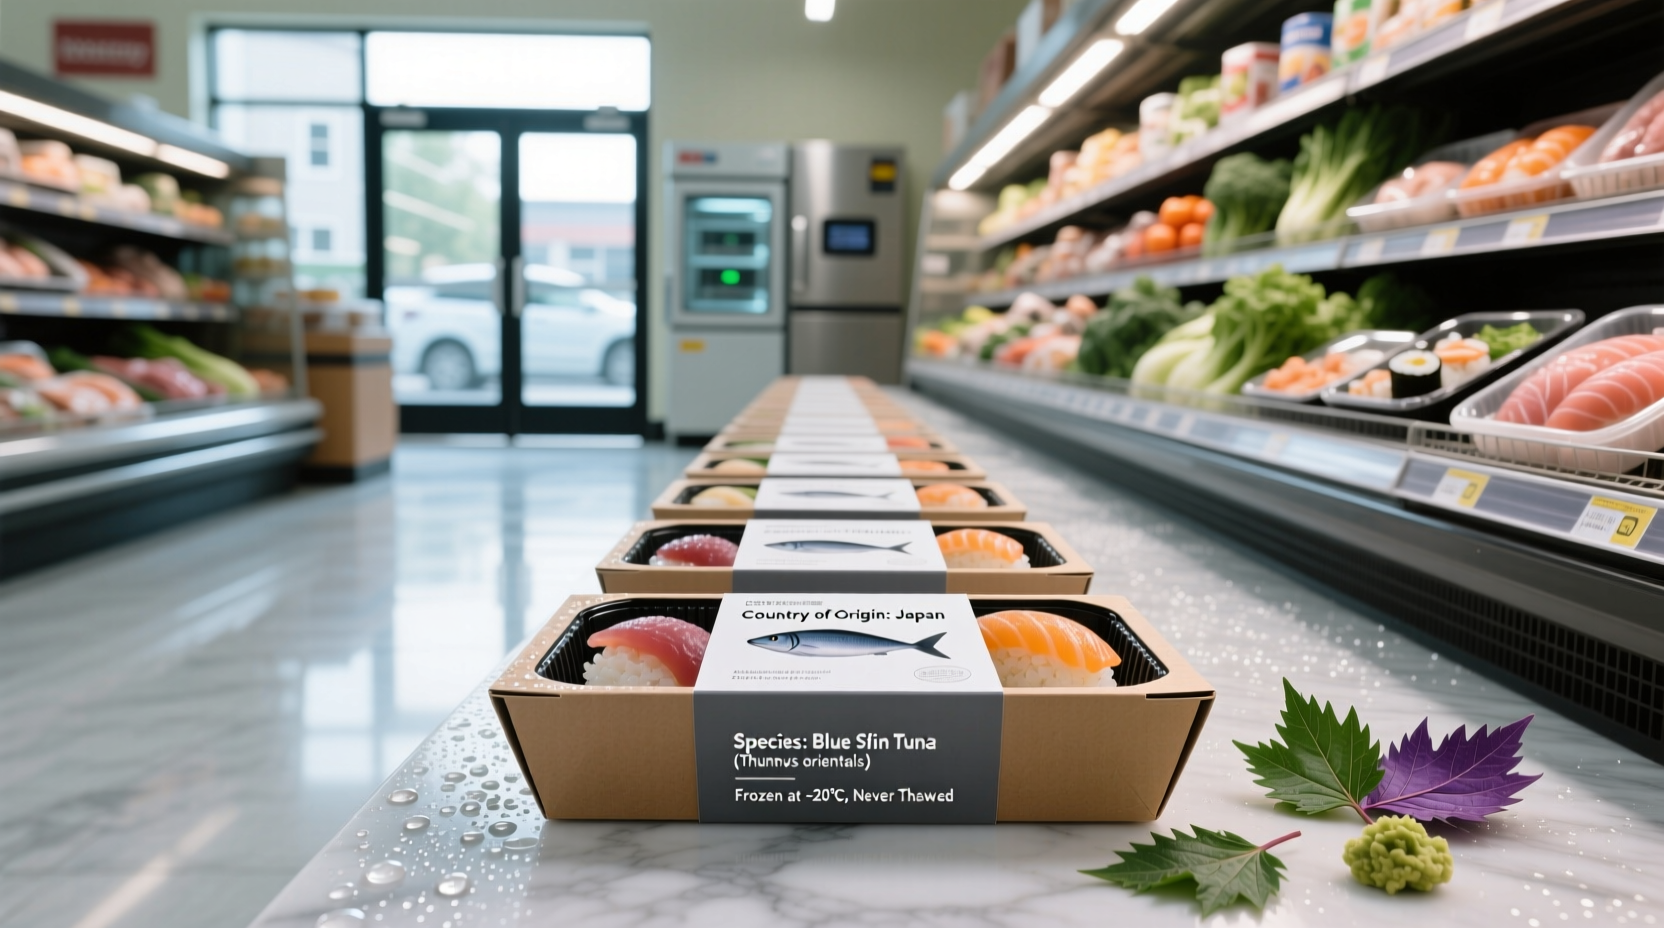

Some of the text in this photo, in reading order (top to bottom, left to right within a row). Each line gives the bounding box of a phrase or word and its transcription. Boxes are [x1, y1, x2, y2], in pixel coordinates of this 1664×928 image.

[742, 608, 945, 623] Country of Origin: Japan
[733, 732, 808, 754] Species:
[812, 731, 851, 750] Blue
[893, 732, 937, 750] Tuna
[735, 788, 783, 802] Frozen
[787, 789, 801, 802] at
[853, 788, 895, 802] Never
[897, 787, 954, 802] Thawed
